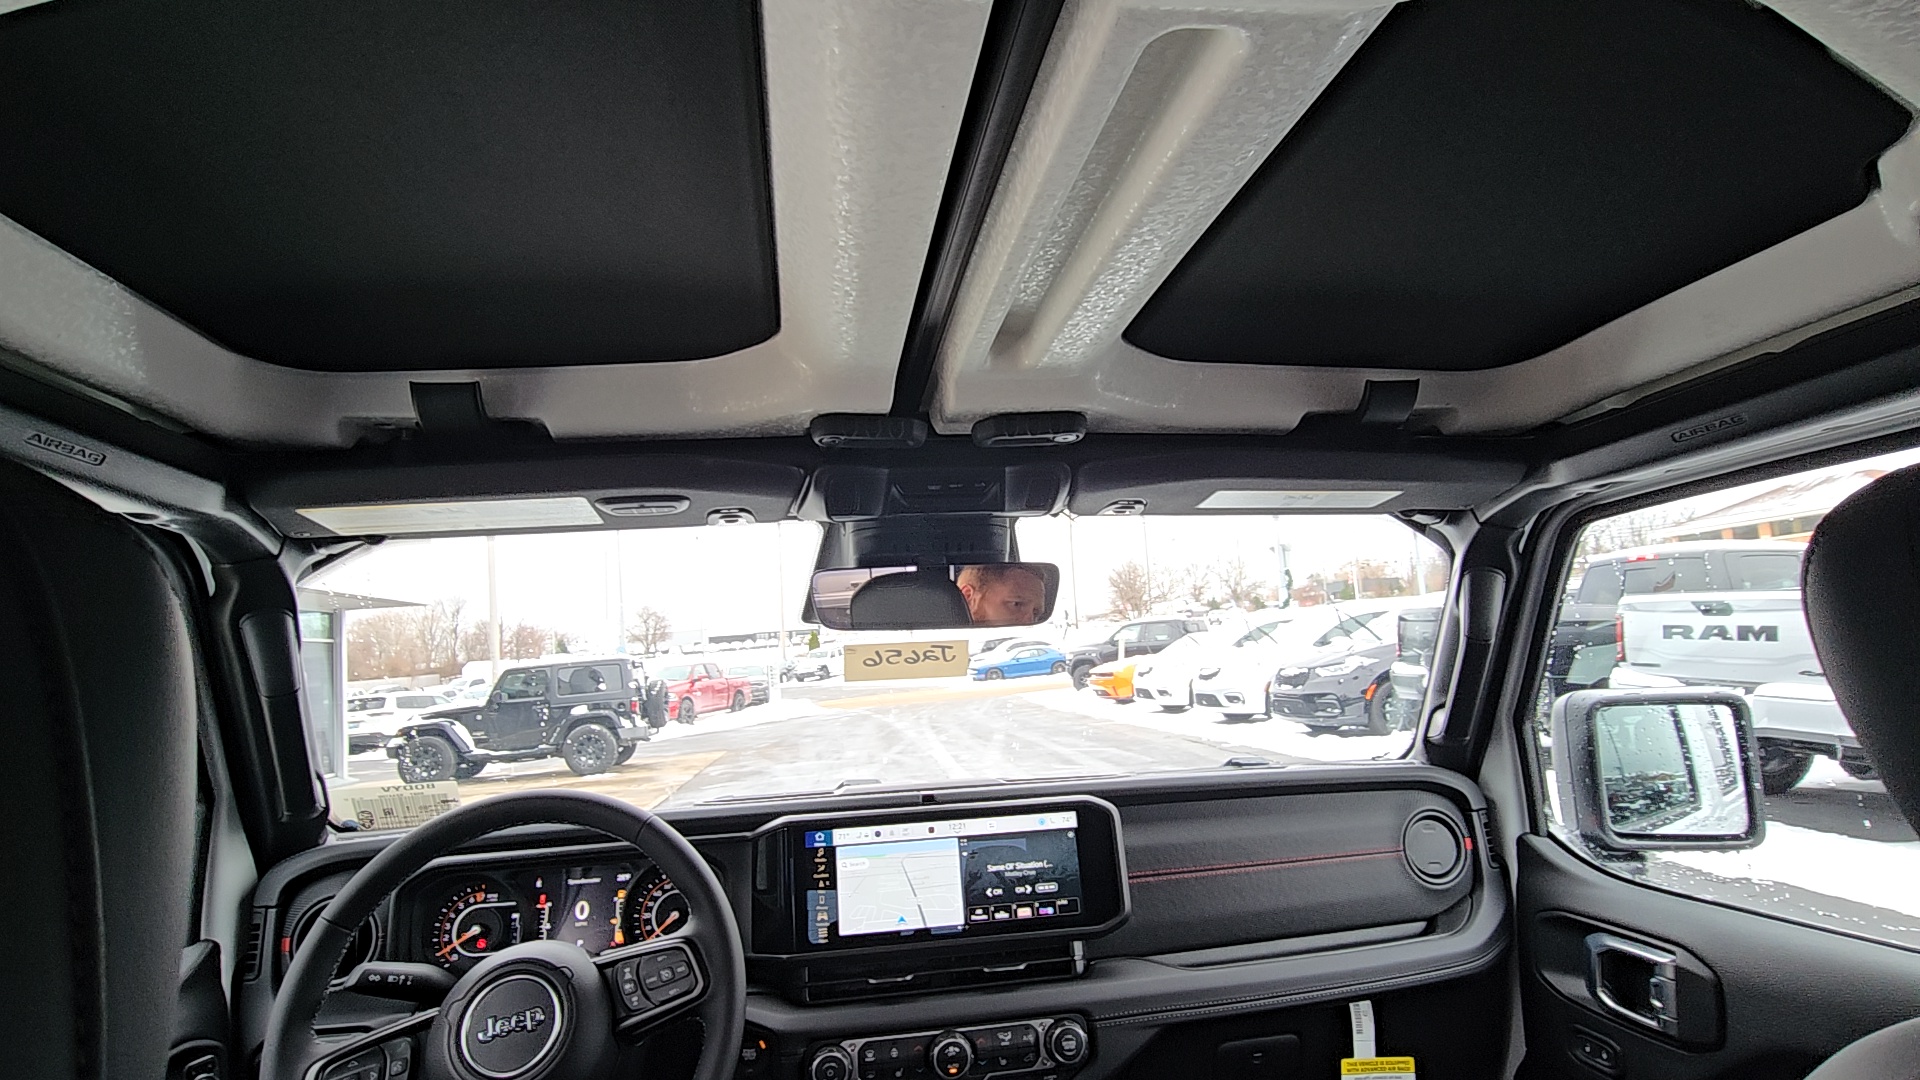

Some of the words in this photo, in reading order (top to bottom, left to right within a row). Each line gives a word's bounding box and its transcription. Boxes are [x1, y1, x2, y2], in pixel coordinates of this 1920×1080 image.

[1677, 416, 1746, 438] AIRBAG
[26, 433, 101, 463] AIRBAG
[1662, 624, 1779, 643] RAM
[948, 822, 966, 831] 12:21
[574, 900, 590, 920] 0
[476, 1006, 546, 1044] Jeep
